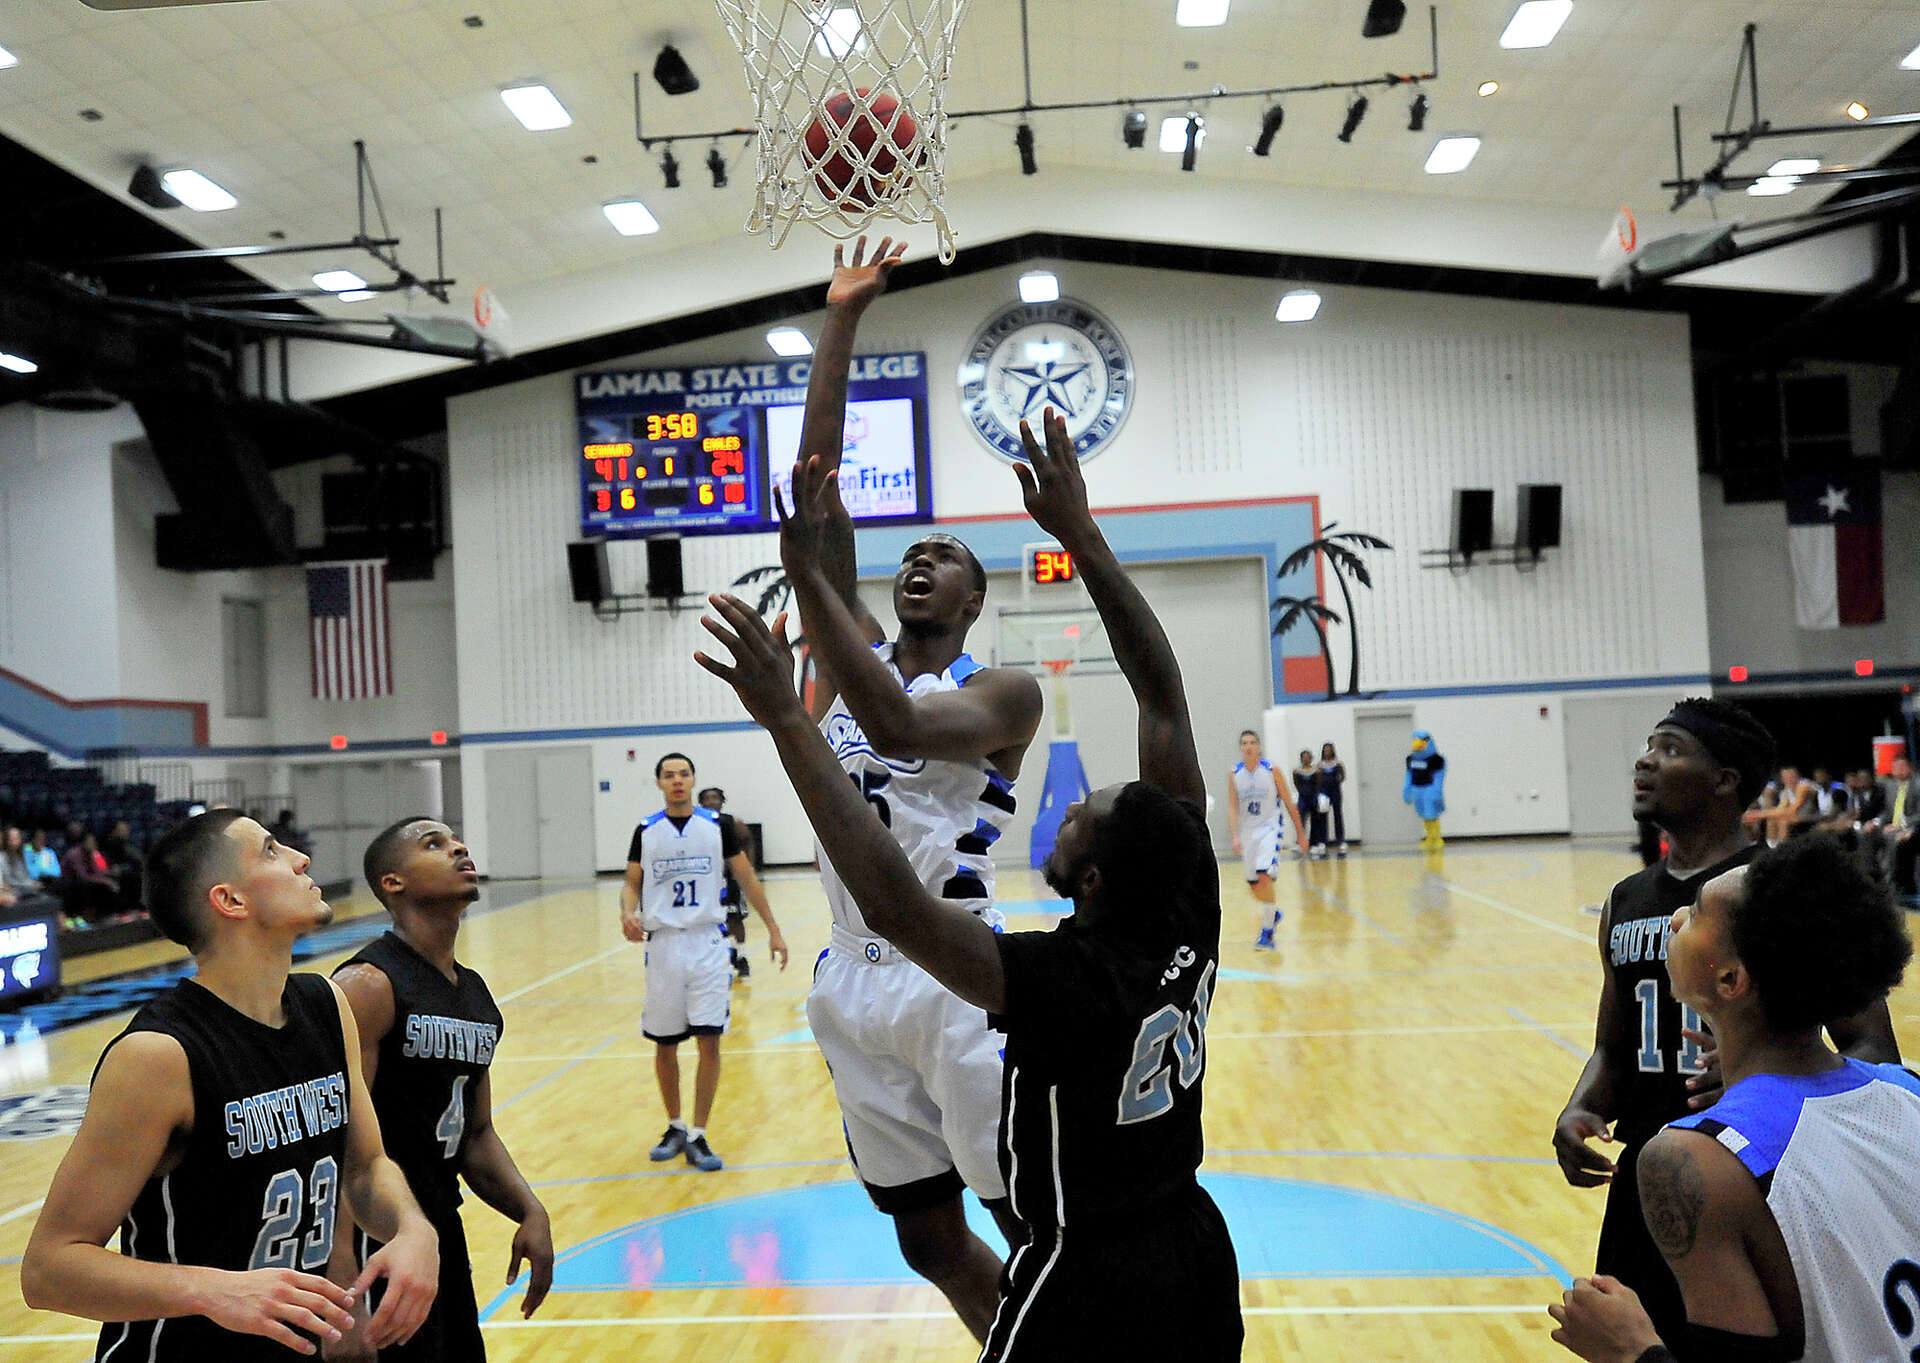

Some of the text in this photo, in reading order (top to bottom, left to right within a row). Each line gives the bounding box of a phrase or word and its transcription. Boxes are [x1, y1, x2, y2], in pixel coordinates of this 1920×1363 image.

[580, 355, 919, 399] LAMAR STATE CLEGE
[685, 391, 734, 408] PORT
[646, 412, 698, 441] 3:58
[594, 457, 628, 482] 41
[664, 457, 674, 476] 1
[711, 450, 744, 476] 24
[596, 489, 611, 512] 3
[620, 488, 636, 510] 6
[698, 483, 715, 505] 6
[1034, 551, 1072, 583] 34
[672, 880, 699, 907] 21
[1634, 978, 1708, 1074] 11
[435, 1075, 469, 1159] 4
[248, 1155, 338, 1271] 23
